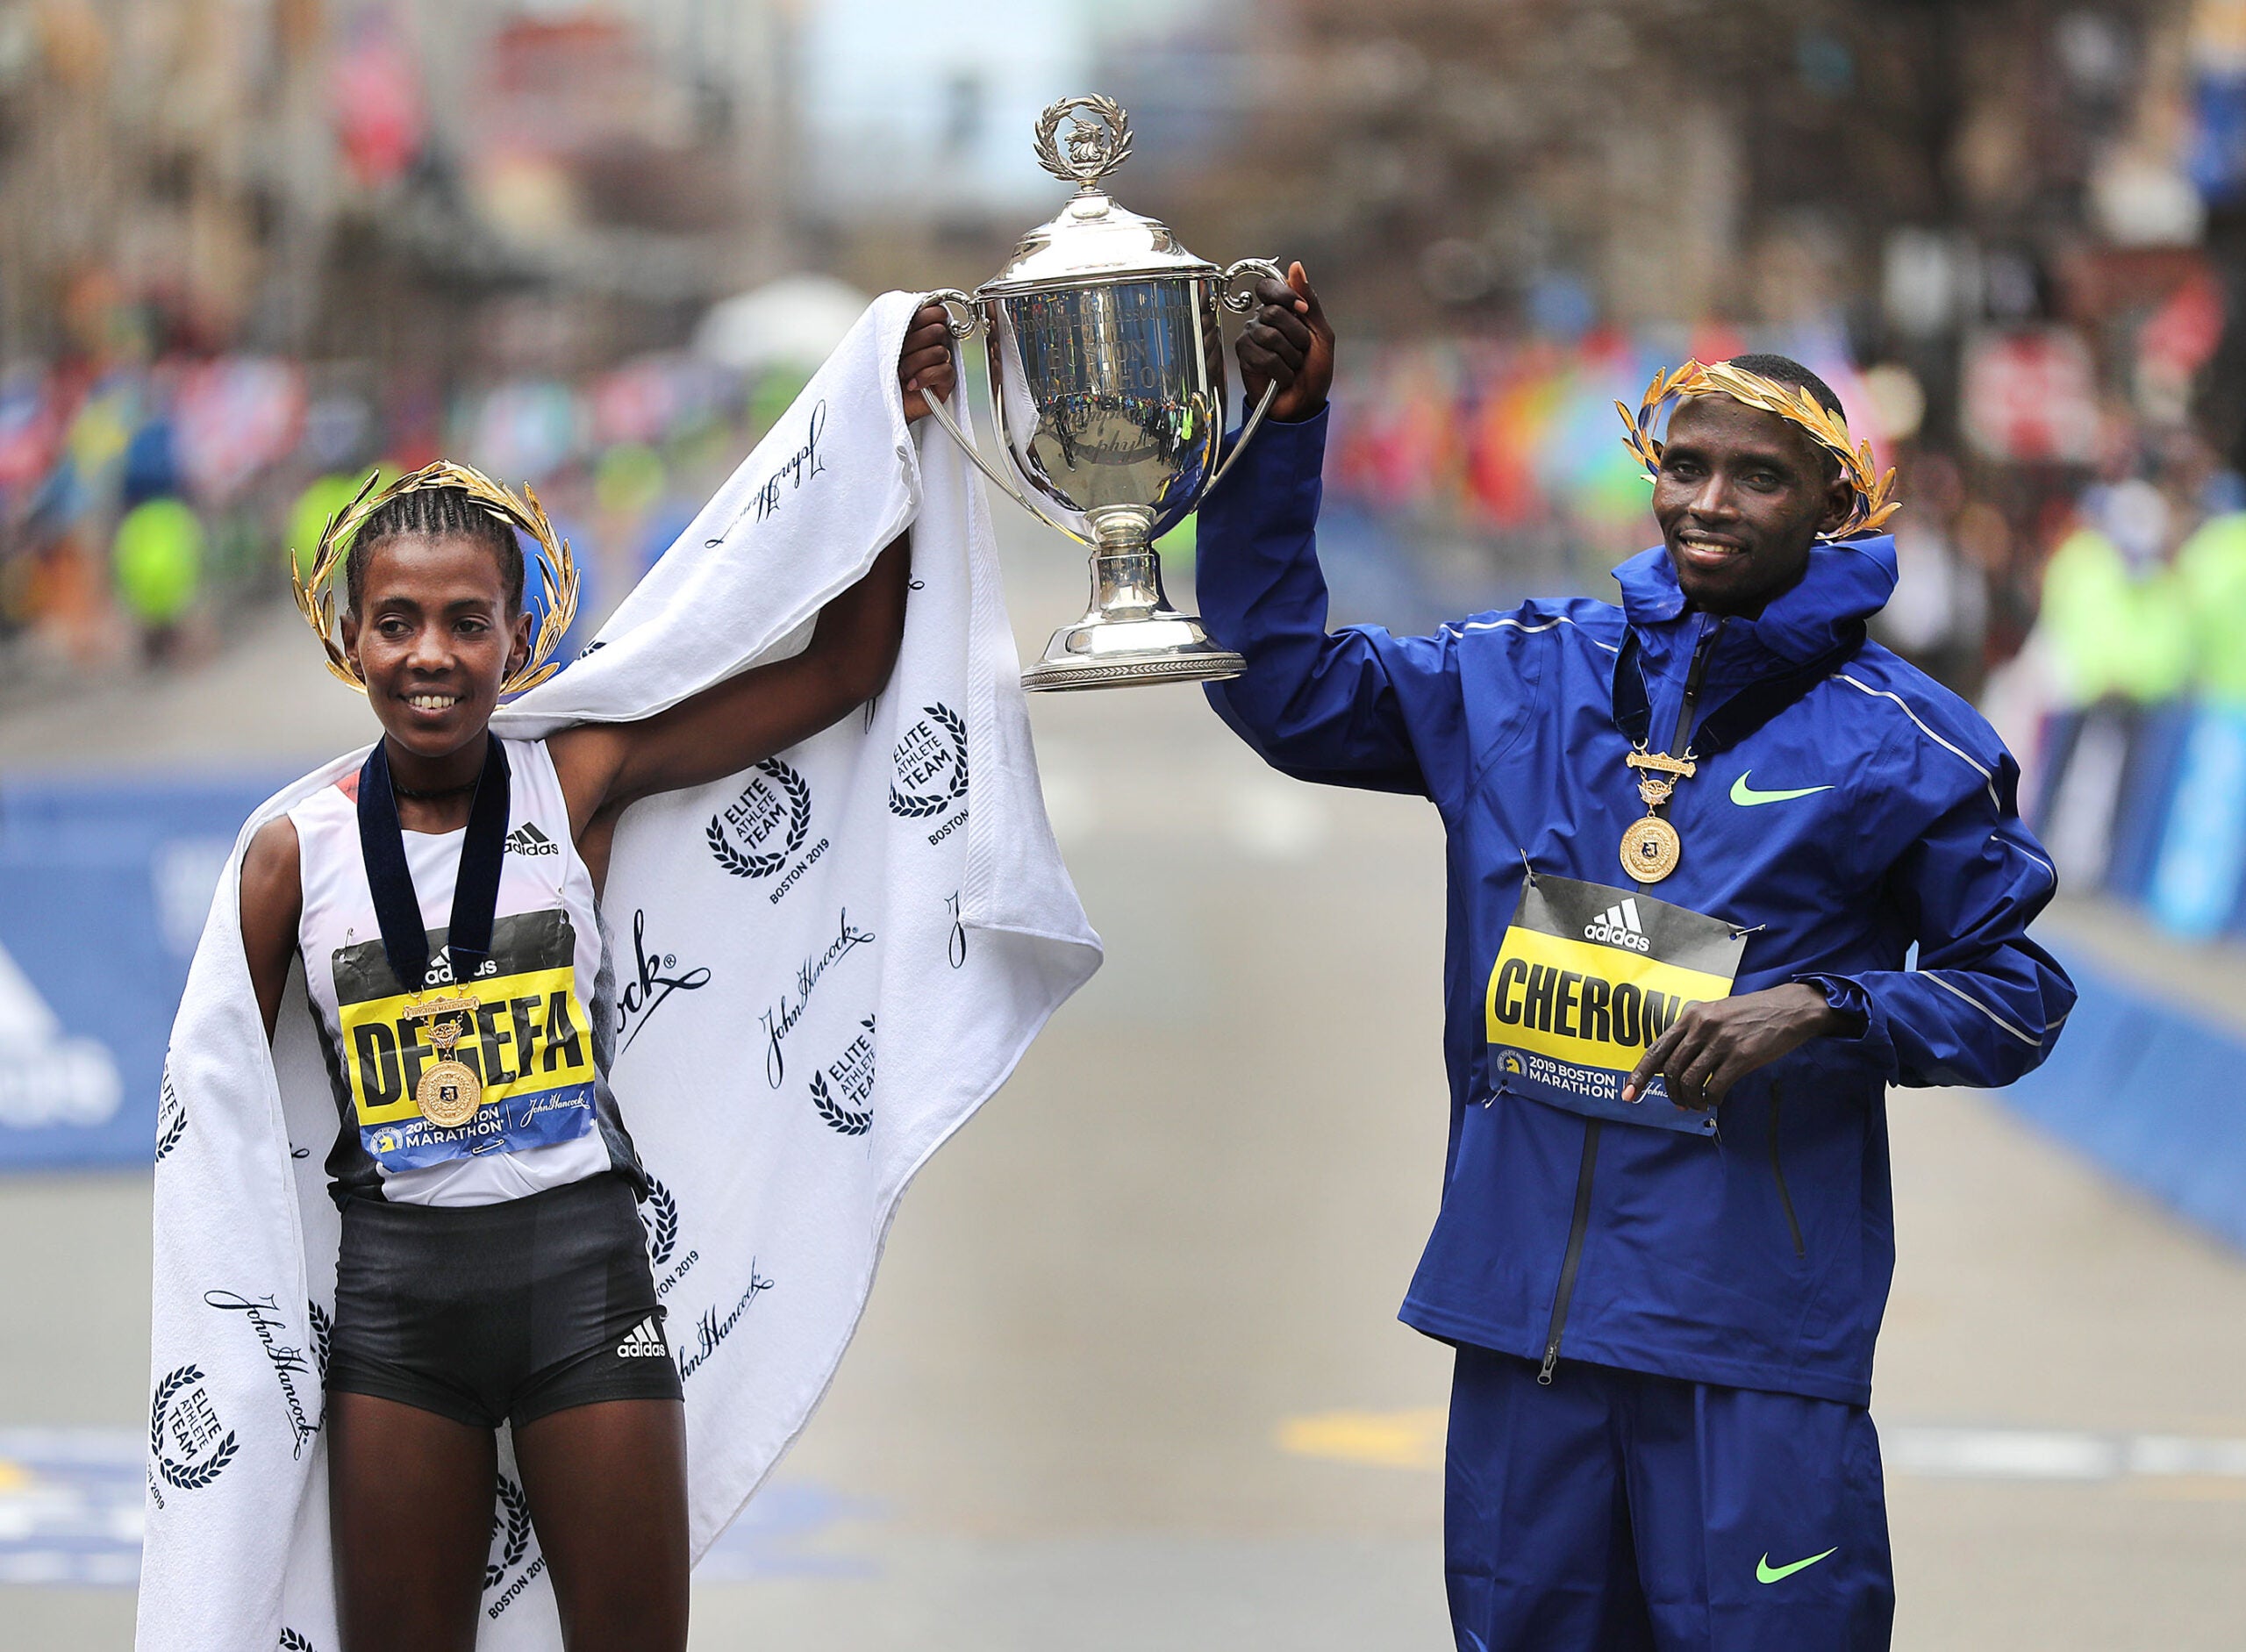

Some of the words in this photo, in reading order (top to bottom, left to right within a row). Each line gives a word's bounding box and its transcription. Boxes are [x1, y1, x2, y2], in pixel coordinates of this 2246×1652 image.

[892, 720, 933, 764] ELITE
[897, 735, 942, 778] ATHLETE
[903, 748, 953, 790] TEAM
[724, 777, 768, 826] ELITE
[735, 793, 777, 838] ATHLETE
[743, 803, 789, 850] TEAM
[928, 808, 969, 846] BOSTON
[504, 842, 559, 855] adidas
[769, 862, 808, 905] BOSTON
[805, 838, 830, 865] 2019
[1584, 924, 1651, 953] adidas
[425, 960, 497, 984] ads
[1495, 958, 1706, 1049] CHERON
[759, 995, 803, 1089] John
[828, 1034, 870, 1082] ELITE
[162, 1063, 178, 1115] LITE
[849, 1068, 875, 1106] TEA
[1528, 1056, 1556, 1074] 2019
[1558, 1064, 1616, 1087] BOSTON
[1529, 1069, 1616, 1100] MARATHON
[465, 1106, 499, 1125] TON
[520, 1098, 549, 1127] John
[548, 1091, 590, 1110] Hancock
[406, 1120, 503, 1148] MARATHON
[675, 1250, 699, 1278] 2019
[678, 1346, 702, 1383] hn
[697, 1255, 774, 1360] Hancock
[617, 1341, 666, 1358] adidas
[204, 1290, 286, 1352] John
[267, 1346, 321, 1461] Hancock
[180, 1398, 209, 1449] ATHLETE
[192, 1388, 222, 1440] ELITE
[168, 1410, 198, 1462] TEAM
[151, 1483, 165, 1510] 2019
[488, 1576, 529, 1620] BOSTON
[526, 1556, 546, 1579] 201
